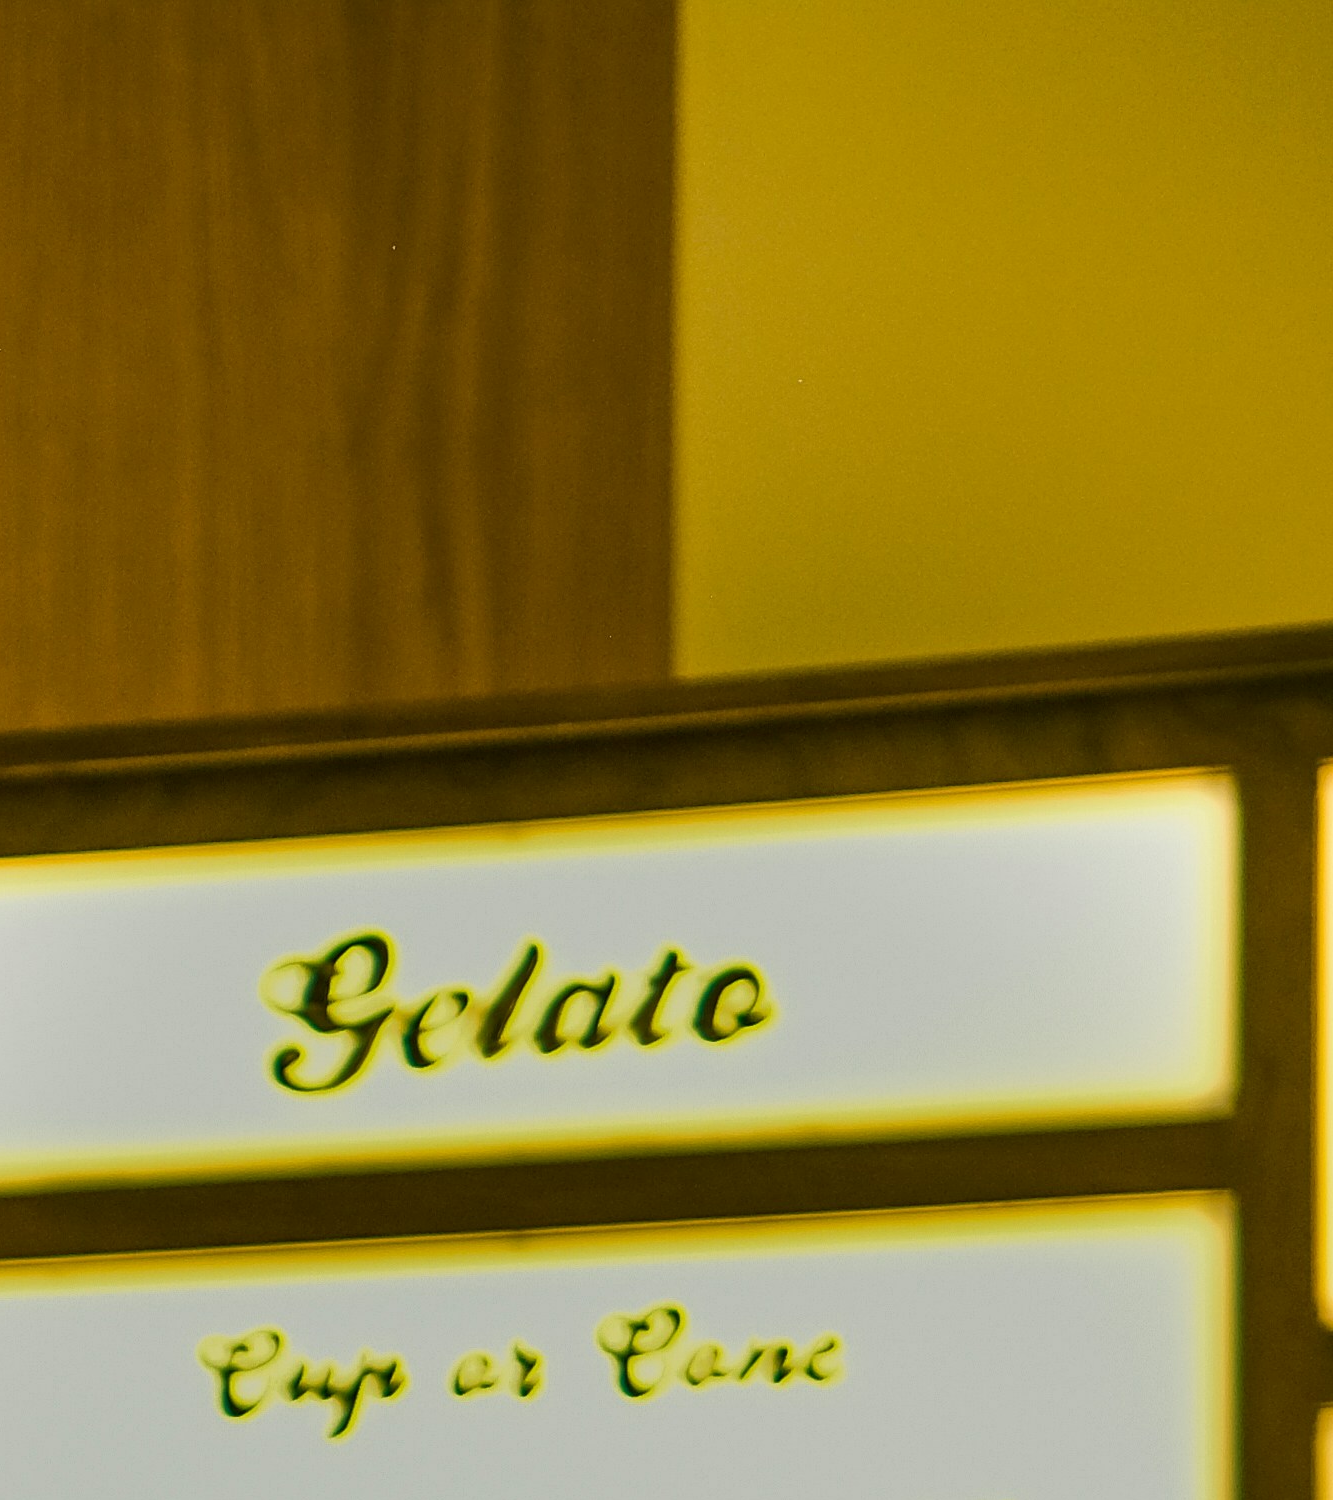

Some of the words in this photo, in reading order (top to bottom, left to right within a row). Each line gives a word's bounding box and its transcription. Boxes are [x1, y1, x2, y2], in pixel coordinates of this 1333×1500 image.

[263, 932, 773, 1092] Gelato
[201, 1329, 406, 1438] Cup
[453, 1345, 542, 1398] or
[598, 1303, 843, 1398] Cone
